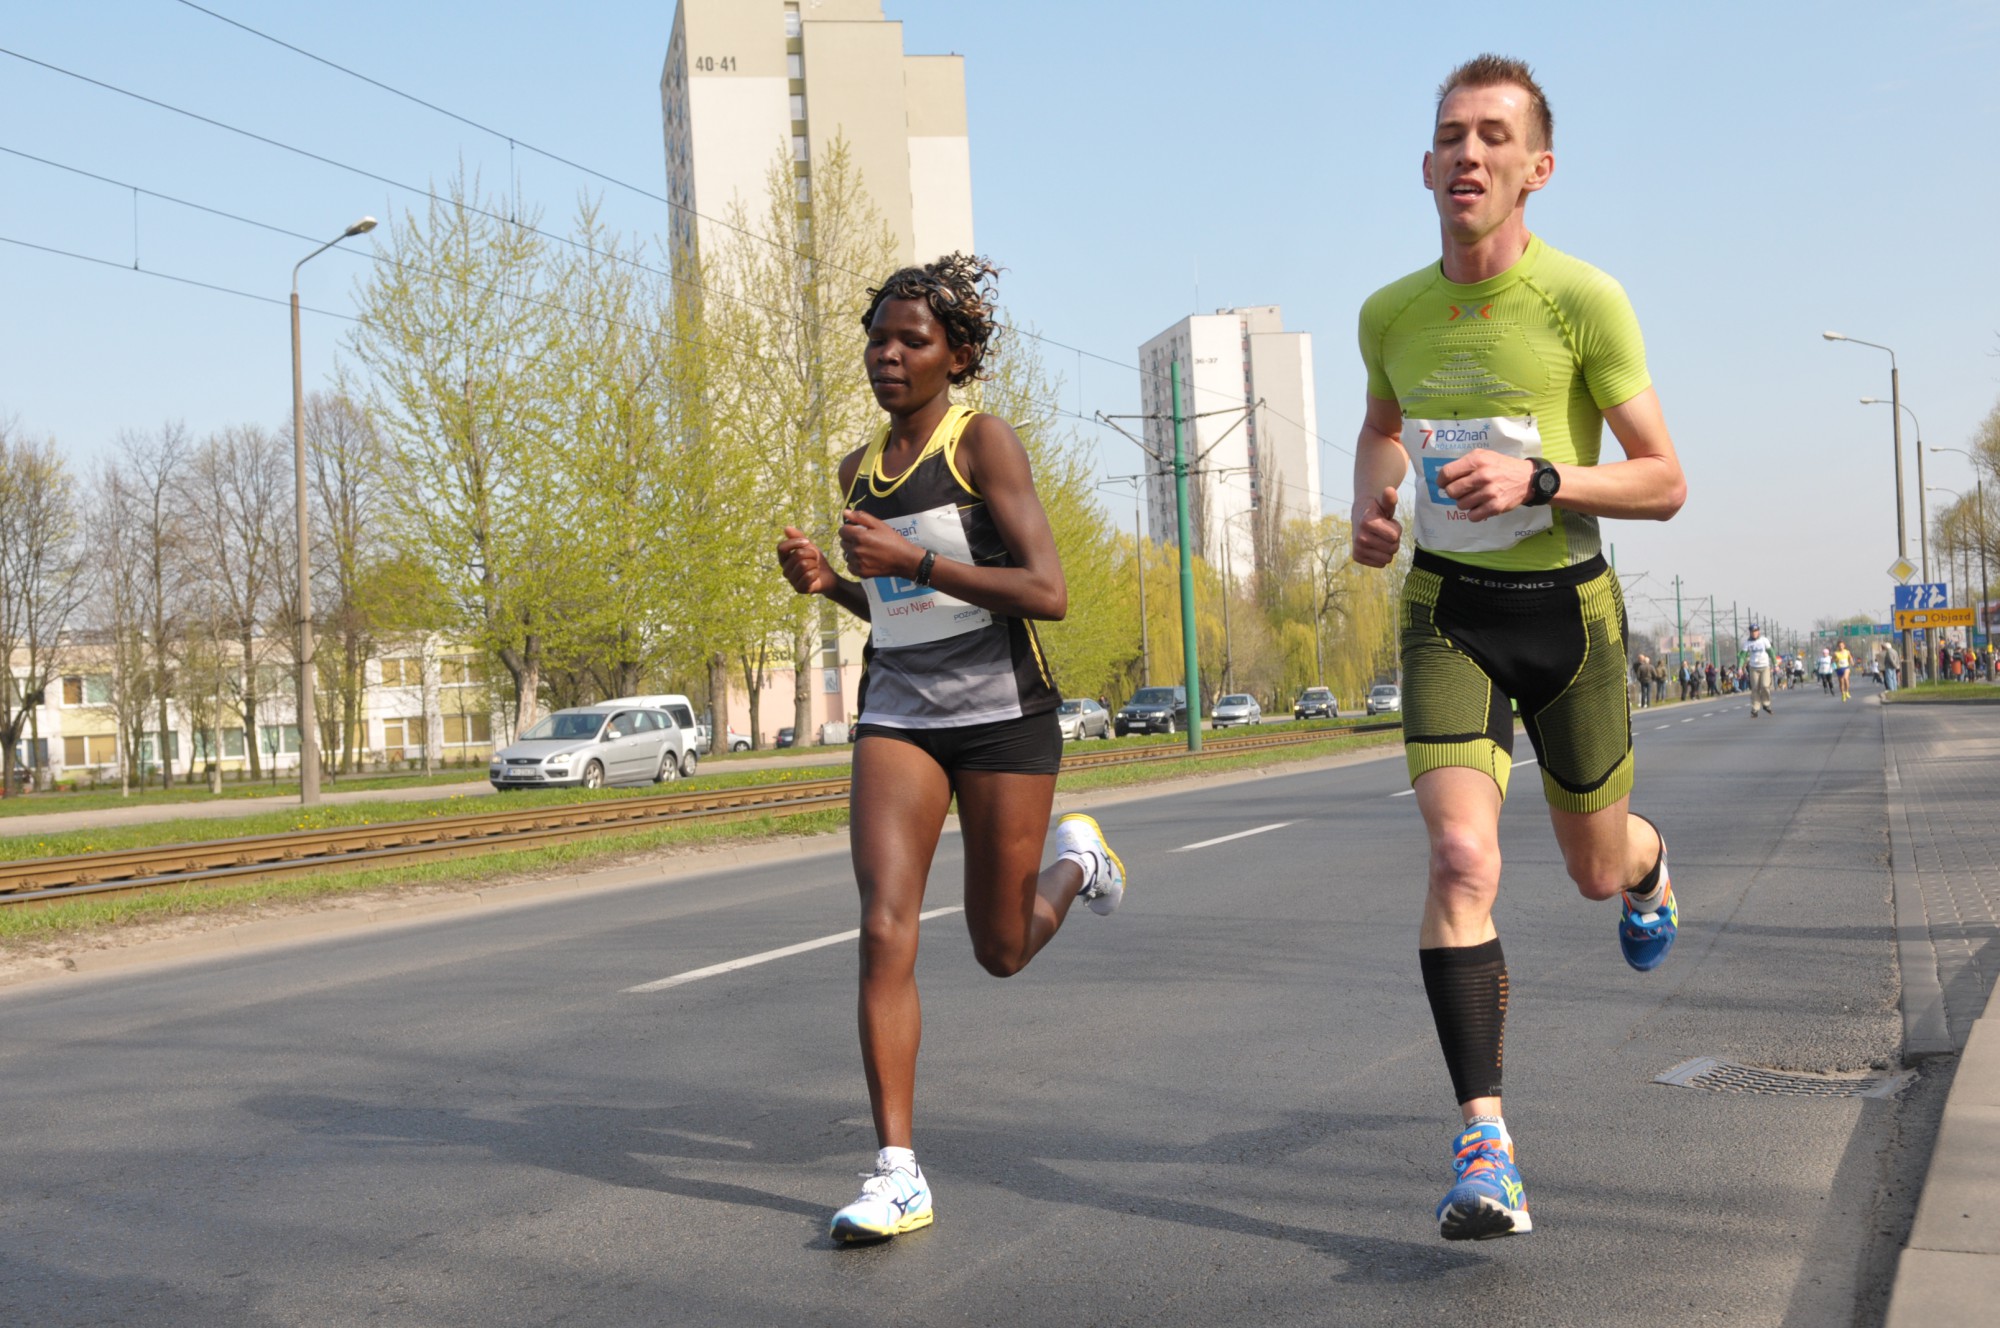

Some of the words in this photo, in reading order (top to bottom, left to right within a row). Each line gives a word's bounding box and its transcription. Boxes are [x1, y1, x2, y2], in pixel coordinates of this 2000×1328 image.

[695, 55, 736, 72] 40-41
[1419, 429, 1433, 450] 7
[1484, 580, 1555, 590] BIONIC
[887, 605, 910, 617] Lucy
